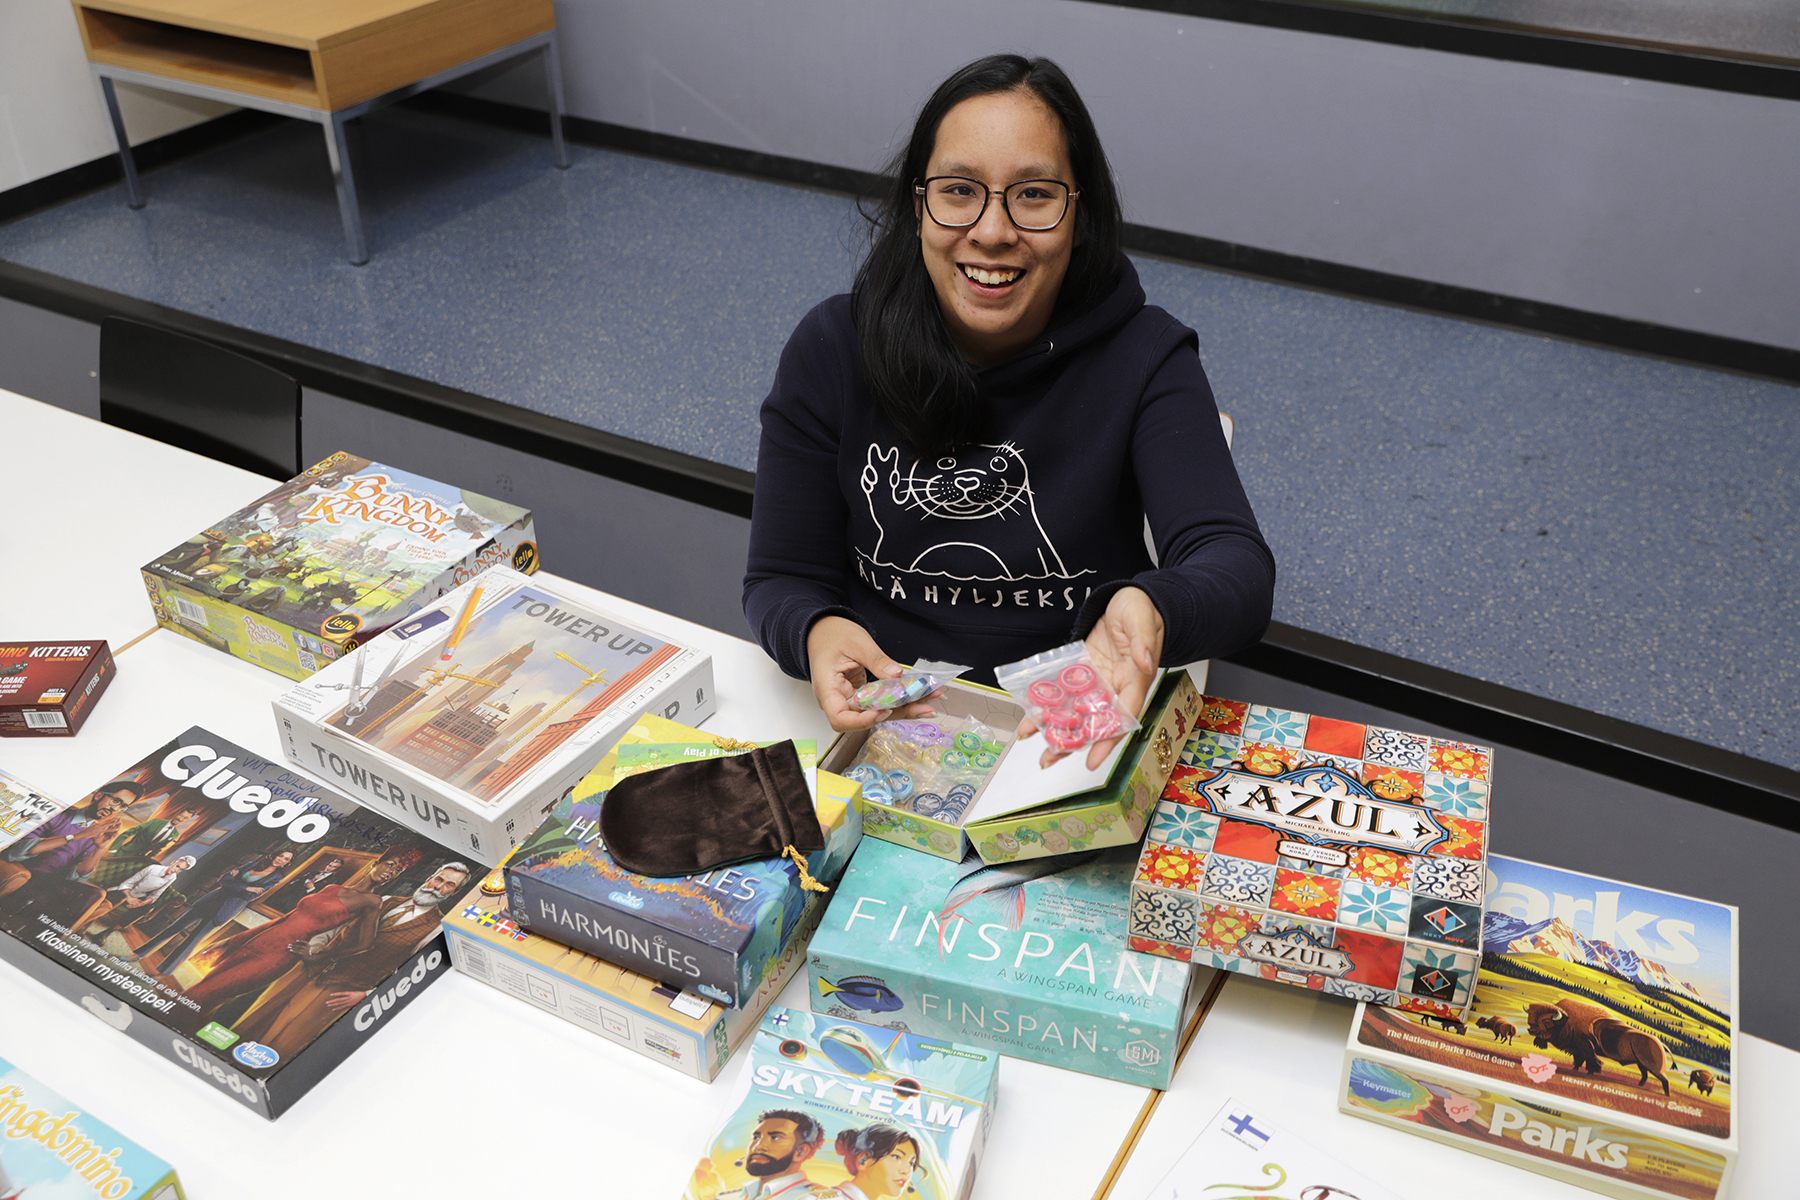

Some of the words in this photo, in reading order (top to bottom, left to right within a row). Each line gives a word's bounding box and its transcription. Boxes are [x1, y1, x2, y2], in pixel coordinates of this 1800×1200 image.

[304, 495, 449, 544] KINGDOM
[335, 475, 455, 527] BUNNY
[451, 542, 503, 586] BUNNY
[514, 547, 535, 567] iello
[857, 556, 907, 599] ÄLÄ
[330, 616, 359, 632] iello
[511, 594, 610, 643] TOWER
[607, 633, 654, 657] UP
[29, 646, 91, 658] KITTENS
[2, 676, 28, 684] GAME
[683, 747, 706, 757] Play
[708, 748, 720, 757] of
[160, 744, 331, 844] Cluedo
[311, 741, 409, 812] TOWER
[410, 793, 451, 830] UP
[1238, 784, 1403, 839] AZUL
[1285, 820, 1317, 833] MICHAEL
[1317, 827, 1351, 838] KIESLING
[1286, 844, 1307, 852] DANSK
[1313, 849, 1340, 859] SVENSKA
[540, 898, 701, 979] HARMONIES
[1486, 868, 1700, 965] arks
[38, 913, 52, 925] Yksi
[50, 919, 72, 937] heistä
[70, 932, 82, 942] on
[109, 955, 132, 971] mutta
[130, 963, 158, 987] kukaan
[156, 982, 165, 992] ei
[164, 987, 178, 997] ole
[177, 992, 202, 1013] viaton.
[844, 896, 1162, 997] FINSPAN
[1257, 941, 1333, 969] AZUL
[36, 929, 97, 969] Klassinen
[94, 963, 177, 1015] mysteeripeli.
[354, 949, 443, 1032] Cluedo
[997, 968, 1008, 979] A
[1014, 970, 1098, 998] WINGSPAN
[1104, 990, 1152, 1010] GAME
[922, 993, 1097, 1054] FINSPAN
[972, 1029, 1025, 1048] WINGSPAN
[1027, 1041, 1057, 1056] GAME
[172, 1038, 259, 1104] Cluedo
[242, 1041, 274, 1064] Hasbro
[1386, 1028, 1402, 1040] The
[1402, 1033, 1439, 1048] National
[1439, 1042, 1465, 1056] Parks
[1465, 1050, 1491, 1063] Board
[1491, 1055, 1516, 1069] Game
[752, 1064, 840, 1099] SKY
[846, 1082, 965, 1129] TEAM
[1363, 1079, 1412, 1100] Keymaster
[1562, 1075, 1591, 1088] HENRY
[1592, 1083, 1638, 1100] AUDUBON
[1644, 1096, 1654, 1104] Art
[1655, 1099, 1666, 1108] by
[0, 1085, 133, 1199] ingdomino
[1488, 1102, 1630, 1171] Parks
